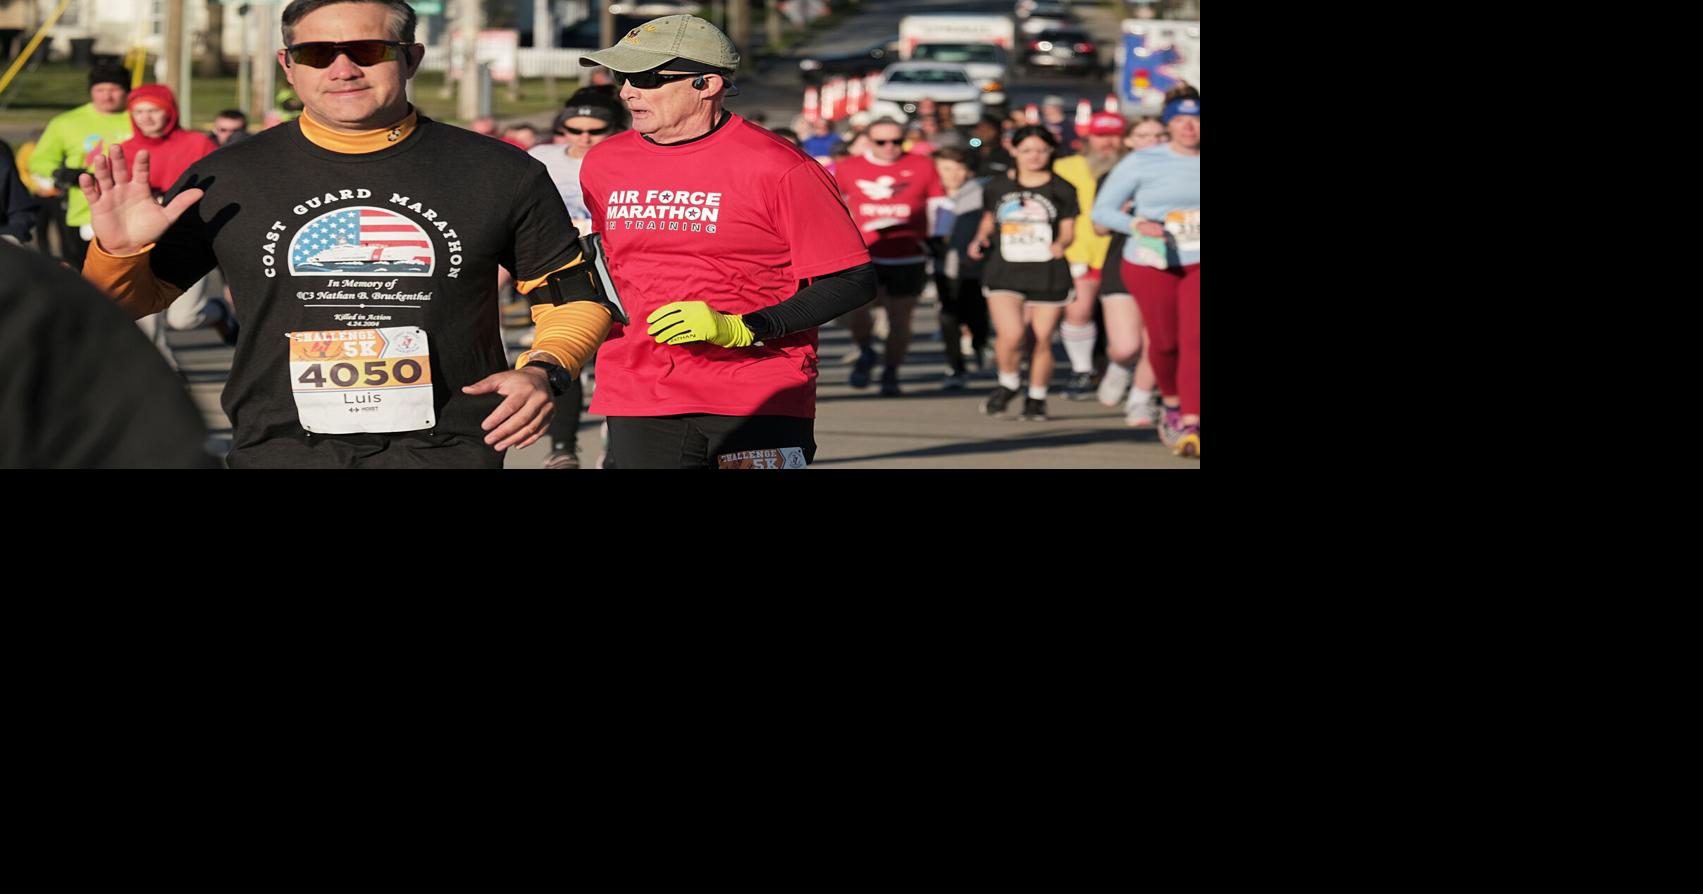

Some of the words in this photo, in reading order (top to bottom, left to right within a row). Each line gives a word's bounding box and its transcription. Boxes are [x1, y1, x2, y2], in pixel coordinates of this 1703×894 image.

[608, 190, 639, 205] AIR
[645, 190, 722, 207] FORCE
[606, 205, 719, 222] MARATHON
[625, 221, 717, 233] TRAINING
[262, 220, 287, 279] COAST
[292, 188, 372, 215] GUARD
[389, 193, 463, 280] MARATHON
[327, 279, 340, 288] In
[341, 279, 383, 290] Memory
[385, 278, 398, 290] of
[316, 291, 355, 300] Nathan
[357, 291, 369, 300] B.
[371, 291, 433, 302] Bruckenthal
[334, 313, 356, 321] Killed
[366, 313, 391, 321] Action
[343, 340, 377, 358] 5K
[298, 358, 422, 388] 4050
[344, 392, 382, 404] Luis
[753, 457, 777, 469] 5K
